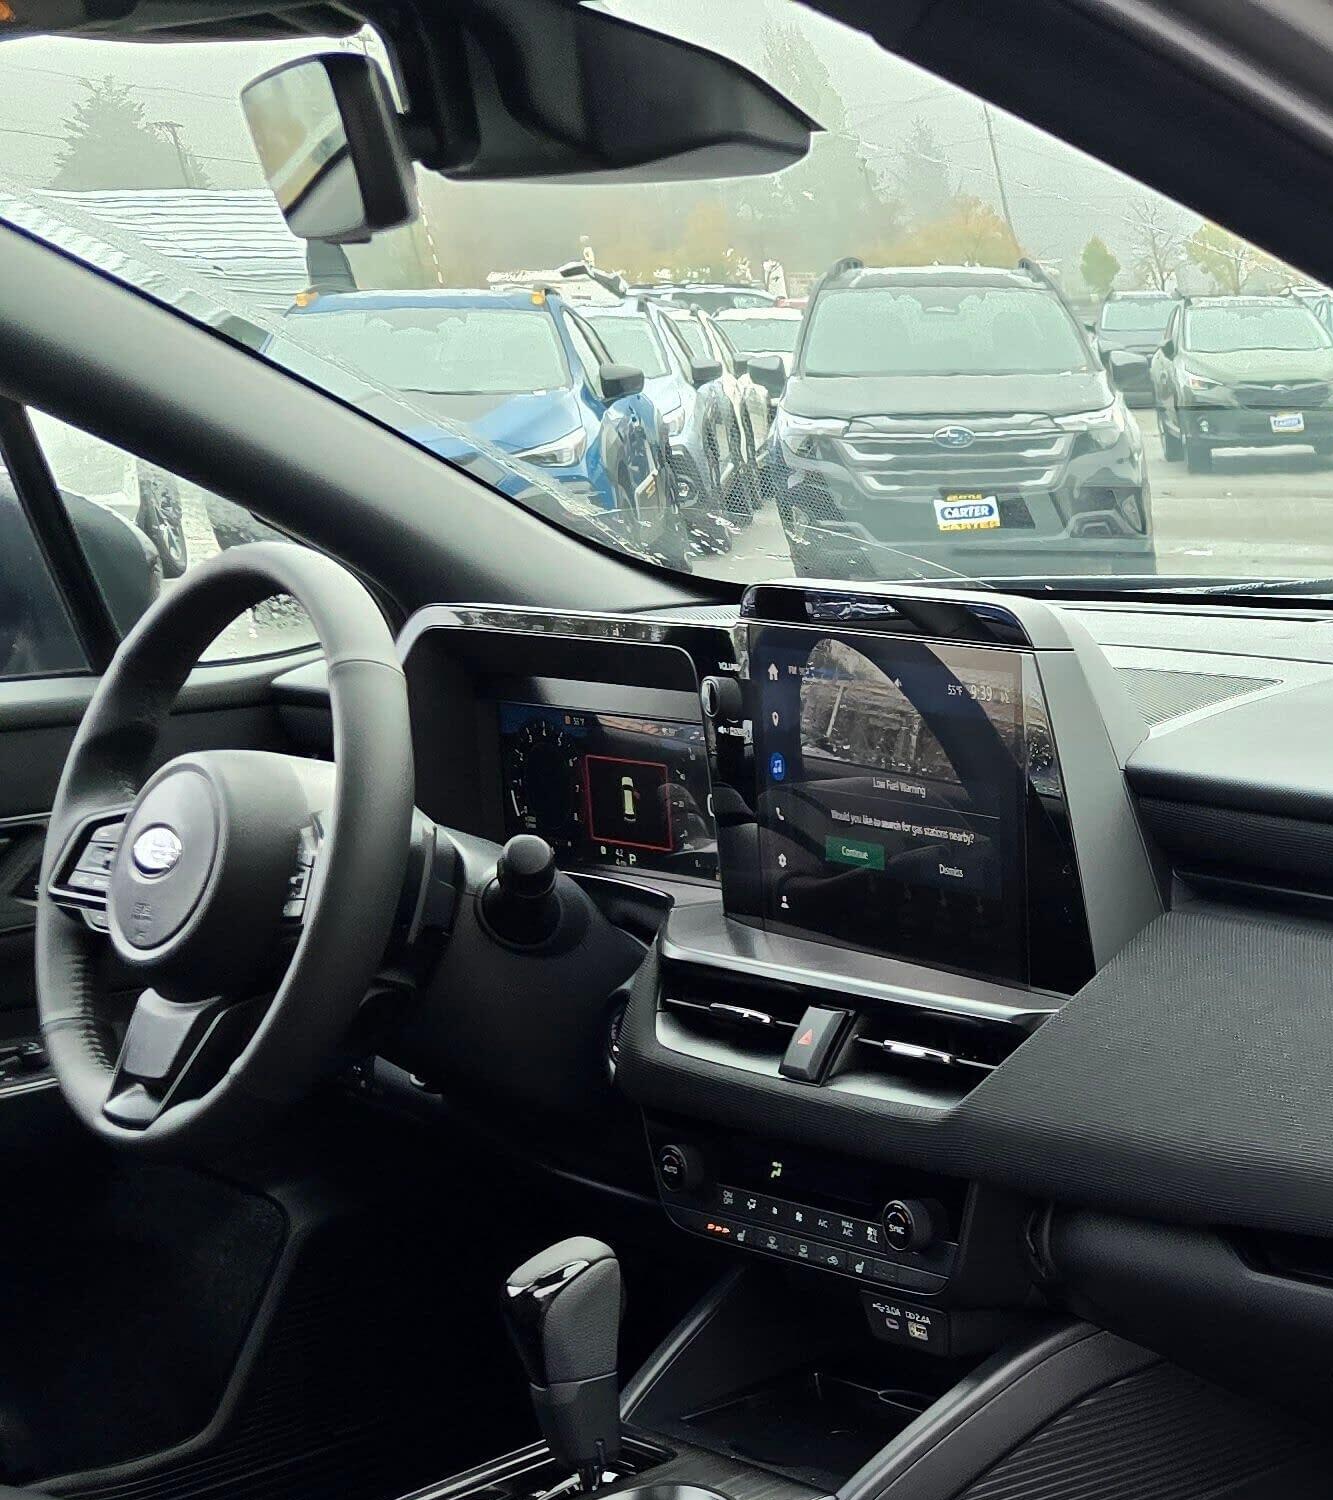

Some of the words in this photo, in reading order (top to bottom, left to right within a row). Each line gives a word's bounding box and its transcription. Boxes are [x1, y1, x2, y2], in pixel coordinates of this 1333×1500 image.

[943, 505, 990, 519] CARTER
[872, 777, 885, 789] Low
[886, 779, 899, 791] Fuel
[900, 782, 926, 798] Warning
[831, 809, 850, 822] Would
[850, 814, 862, 825] you
[862, 815, 873, 826] like
[901, 821, 912, 832] for
[912, 825, 923, 836] gas
[924, 827, 949, 839] stations
[949, 831, 975, 845] nearby?
[629, 853, 638, 866] P
[841, 845, 869, 860] Continue
[938, 863, 964, 878] Dismiss
